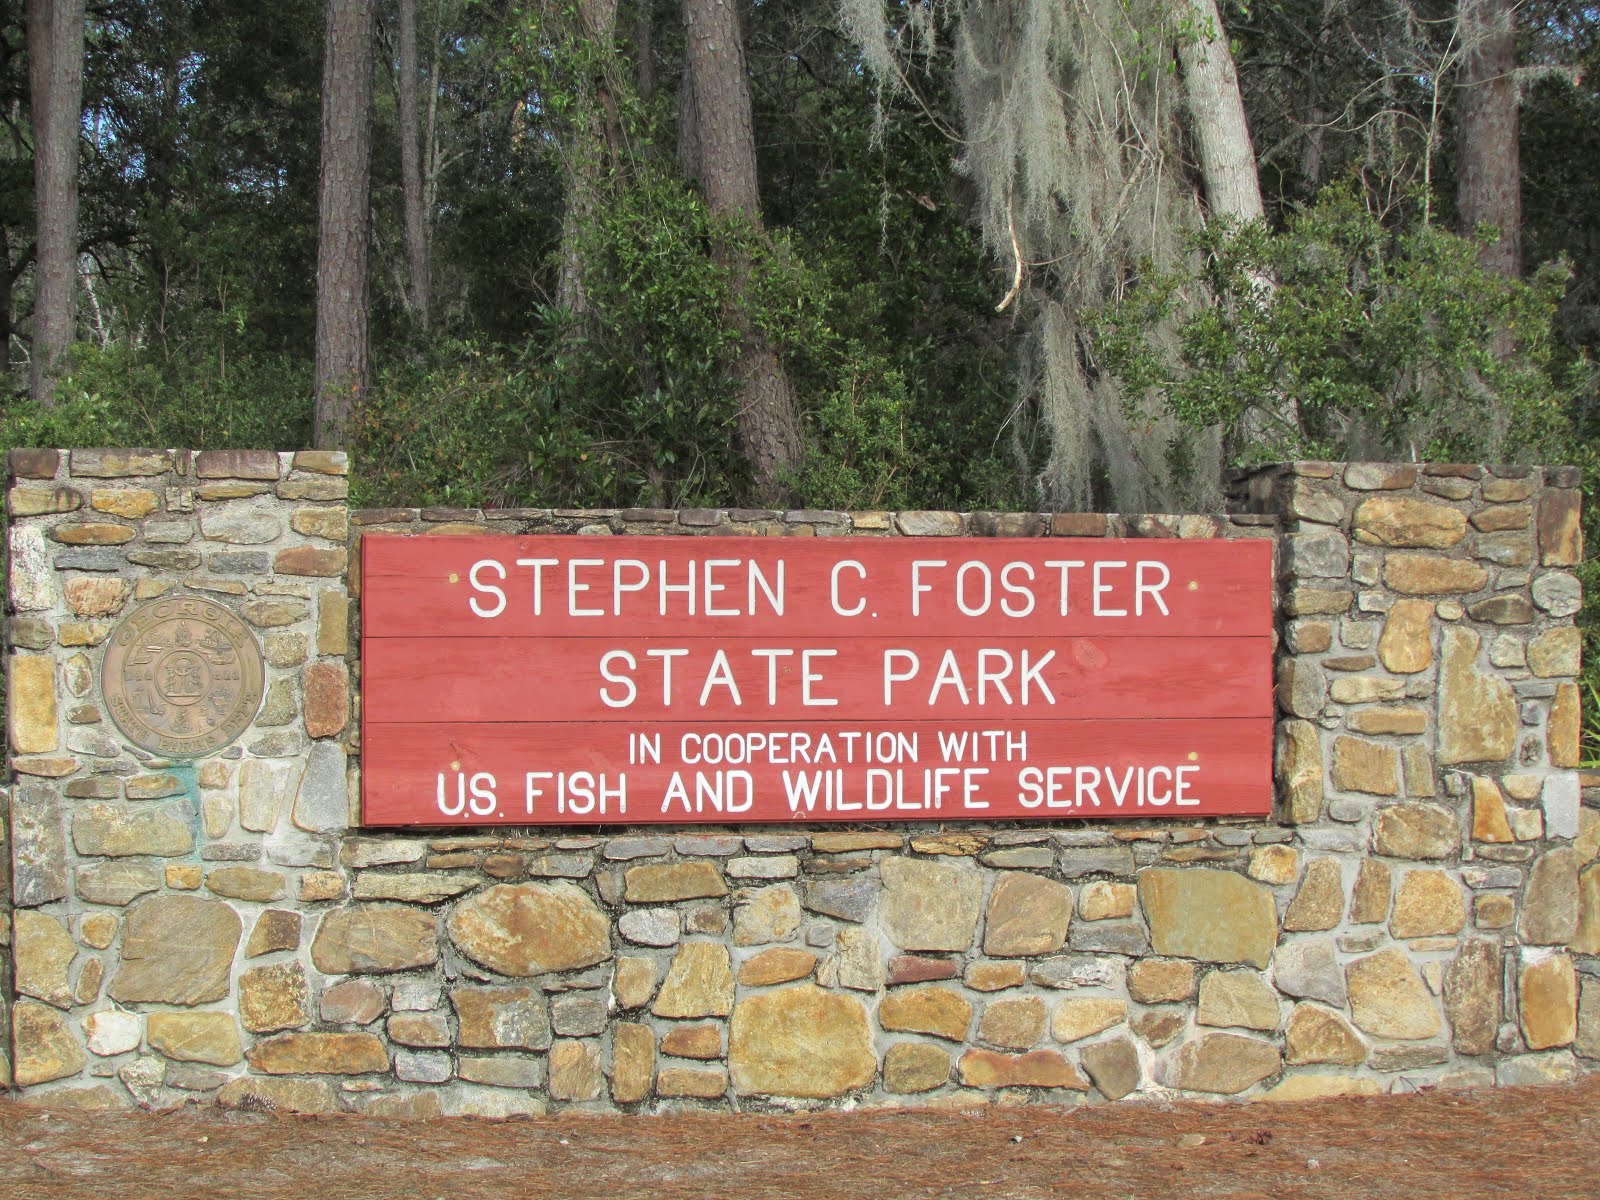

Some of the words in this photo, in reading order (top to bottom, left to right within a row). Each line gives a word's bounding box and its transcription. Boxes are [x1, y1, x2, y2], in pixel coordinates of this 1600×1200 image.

[469, 558, 785, 618] STEPHEN
[830, 559, 879, 618] C.
[911, 560, 1171, 618] FOSTER
[117, 601, 249, 648] GEORGIA
[599, 648, 839, 708] STATE
[883, 648, 1056, 706] PARK
[110, 694, 151, 742] STATE
[156, 736, 217, 754] PARKS
[629, 732, 661, 765] IN
[680, 731, 919, 765] COOPERATION
[937, 730, 1027, 763] WITH
[436, 771, 504, 818] U.S.
[525, 770, 627, 815] FISH
[660, 769, 754, 813] AND
[781, 767, 990, 812] WILDLIFE
[1018, 765, 1201, 809] SERVICE
